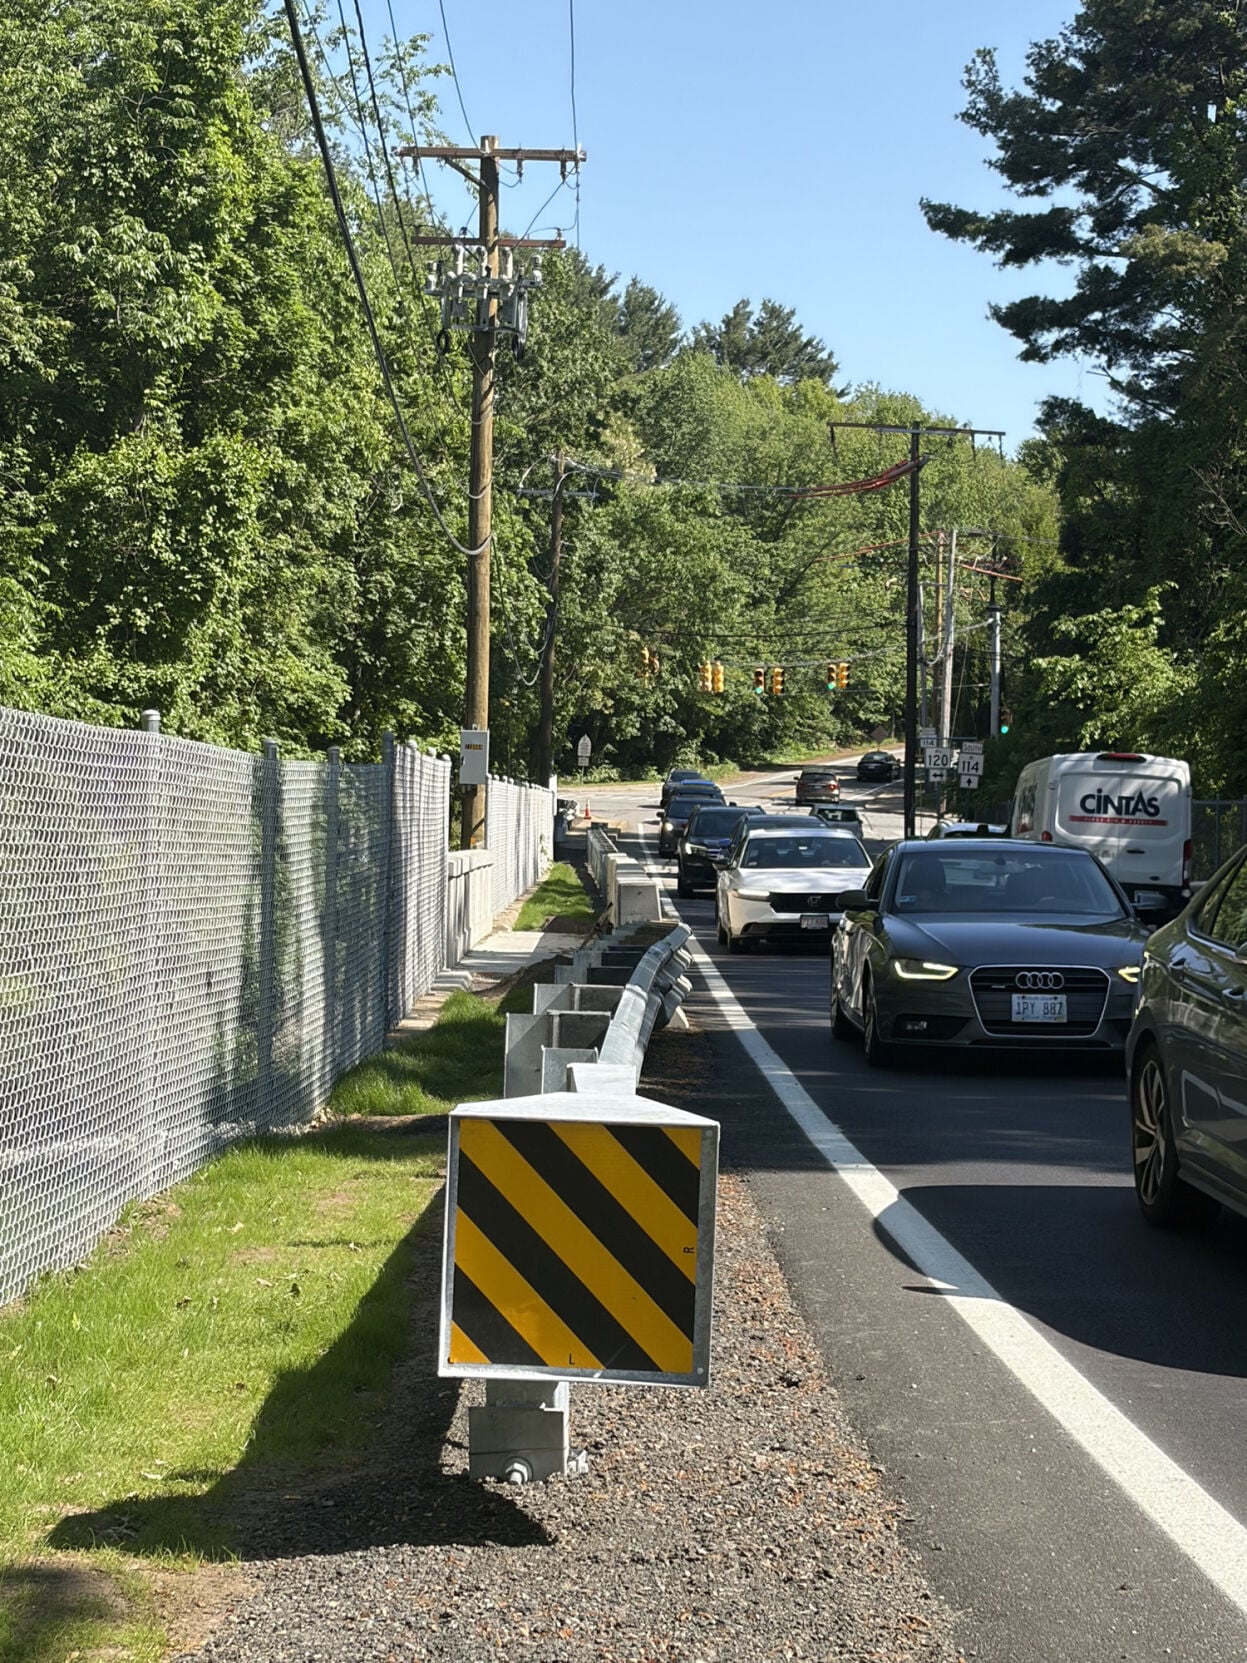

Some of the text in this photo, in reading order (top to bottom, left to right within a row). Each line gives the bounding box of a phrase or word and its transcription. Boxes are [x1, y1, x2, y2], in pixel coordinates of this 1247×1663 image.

[928, 754, 949, 767] 120
[962, 760, 979, 773] 114
[683, 1246, 695, 1254] R
[568, 1352, 575, 1365] L
